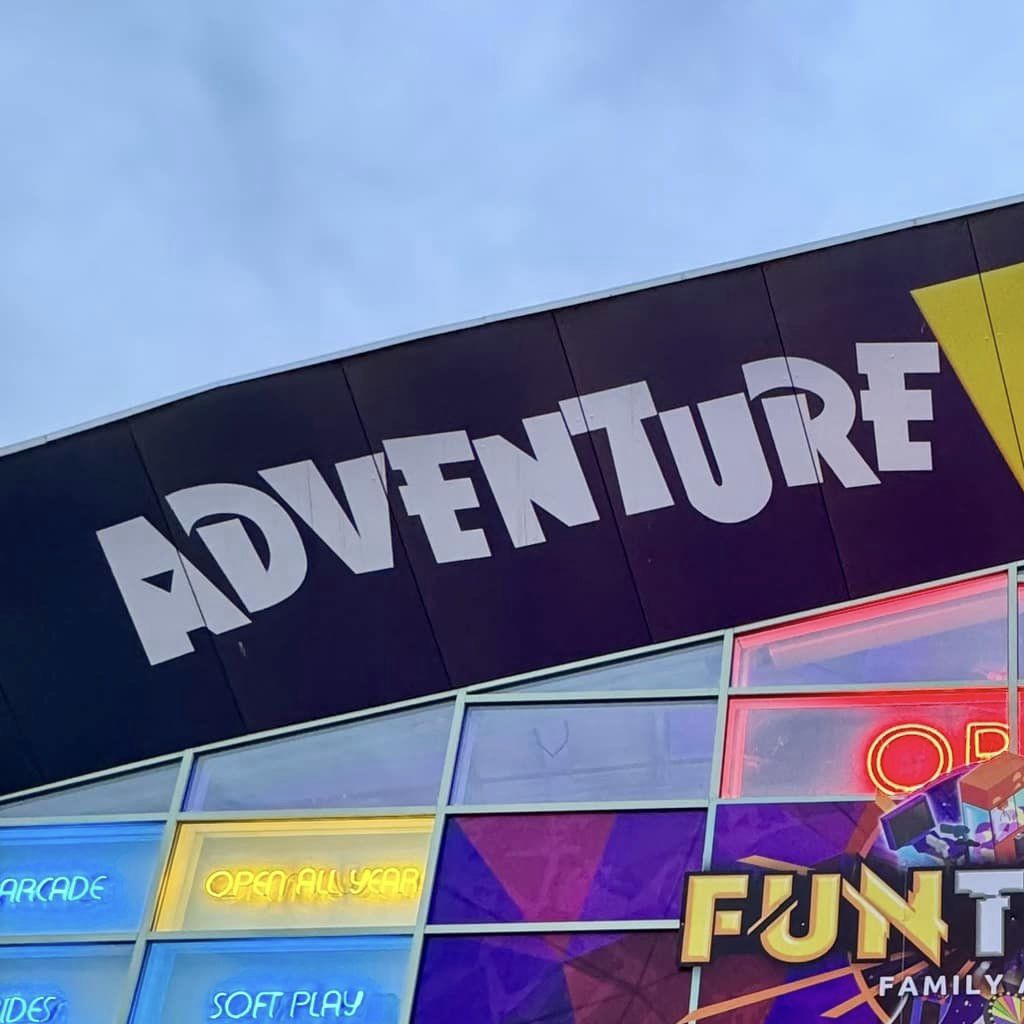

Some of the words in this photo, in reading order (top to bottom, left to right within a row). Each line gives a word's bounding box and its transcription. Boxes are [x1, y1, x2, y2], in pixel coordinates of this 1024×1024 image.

[96, 342, 940, 666] ADVENTURE
[0, 875, 107, 902] ARCADE
[205, 869, 285, 898] OPEN
[294, 868, 341, 896] ALL
[349, 867, 423, 895] YEAR
[879, 974, 1003, 997] FAMILY
[0, 995, 57, 1024] IDES
[209, 990, 284, 1019] SOFT
[289, 989, 364, 1018] PLAY
